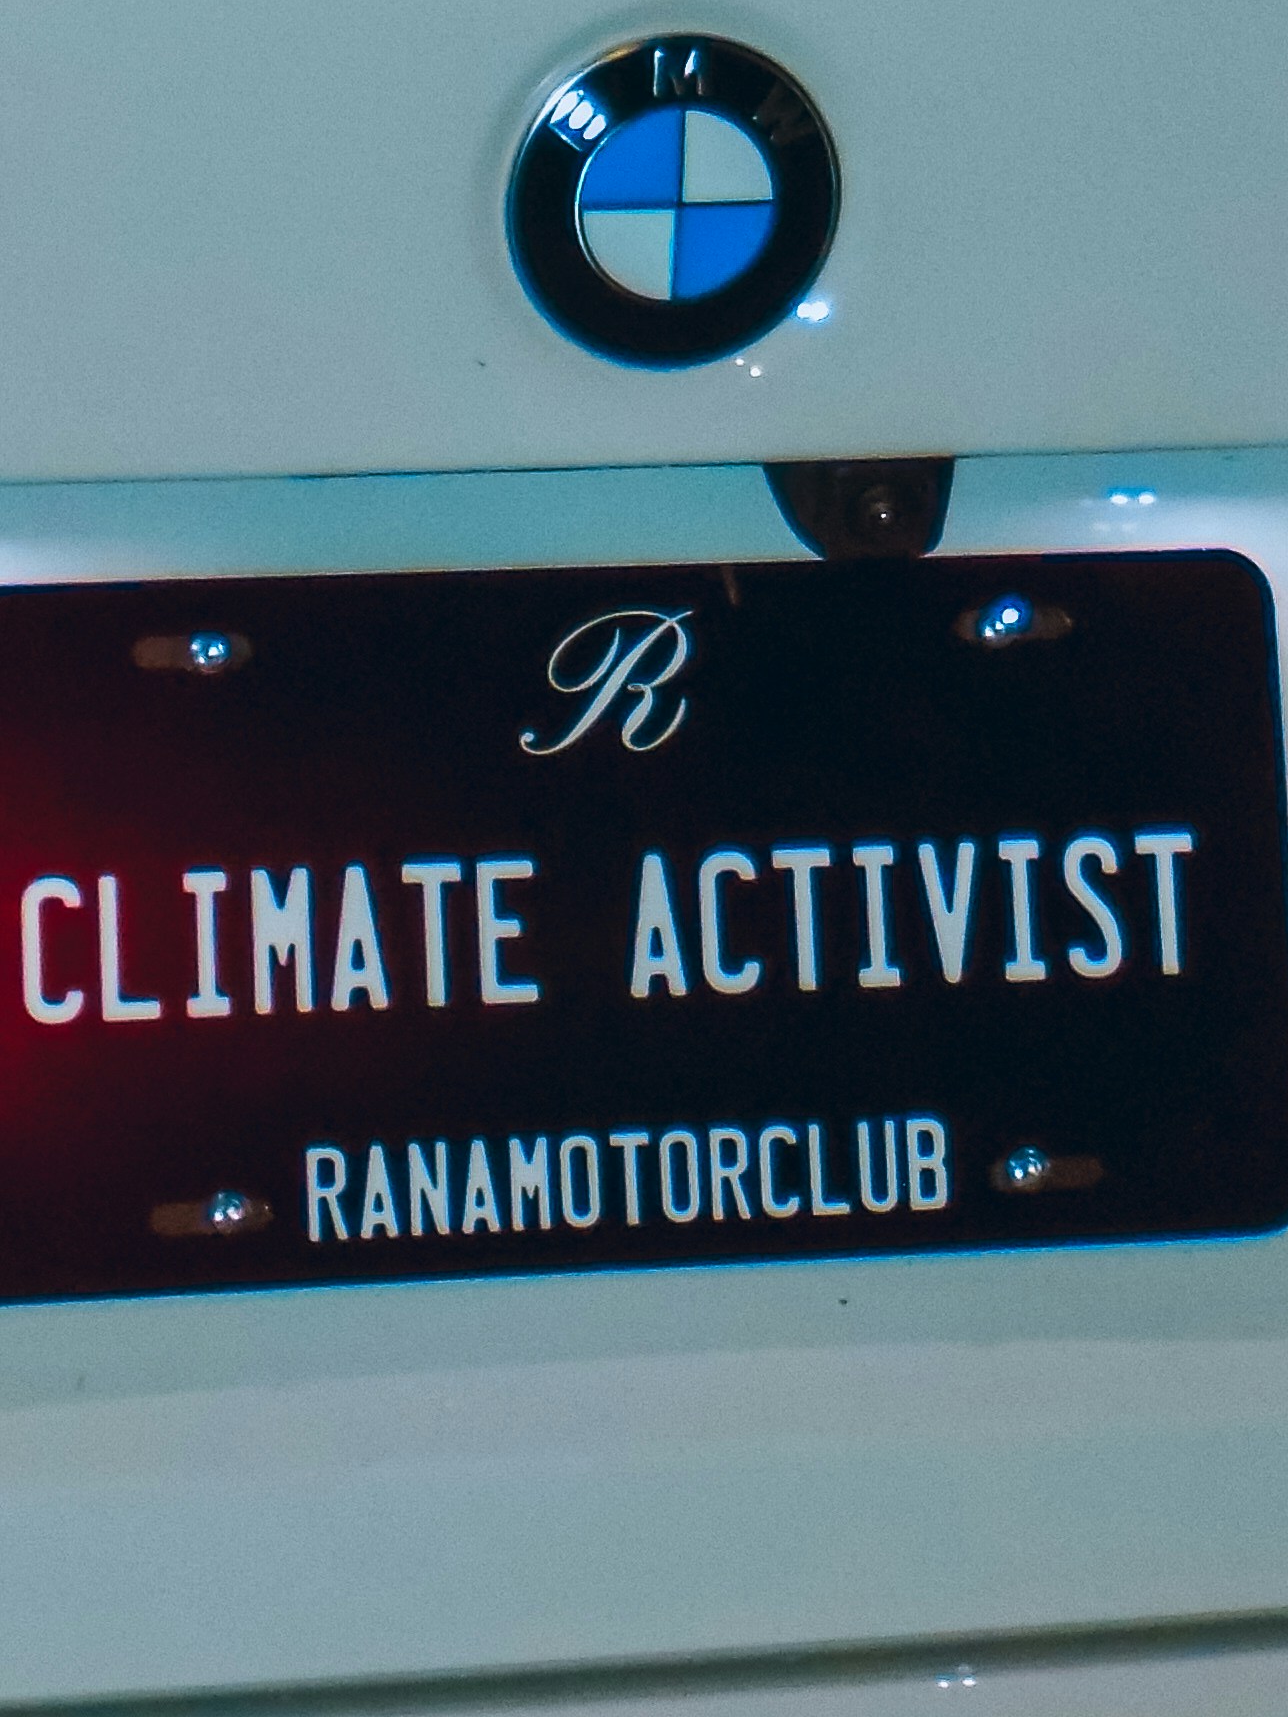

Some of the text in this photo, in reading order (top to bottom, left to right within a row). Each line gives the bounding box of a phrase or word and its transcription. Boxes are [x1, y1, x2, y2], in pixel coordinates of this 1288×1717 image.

[520, 610, 694, 756] R
[20, 830, 1194, 1026] CLIMATE ACTIVIST
[304, 1117, 951, 1244] RANAMOTORCLUB
